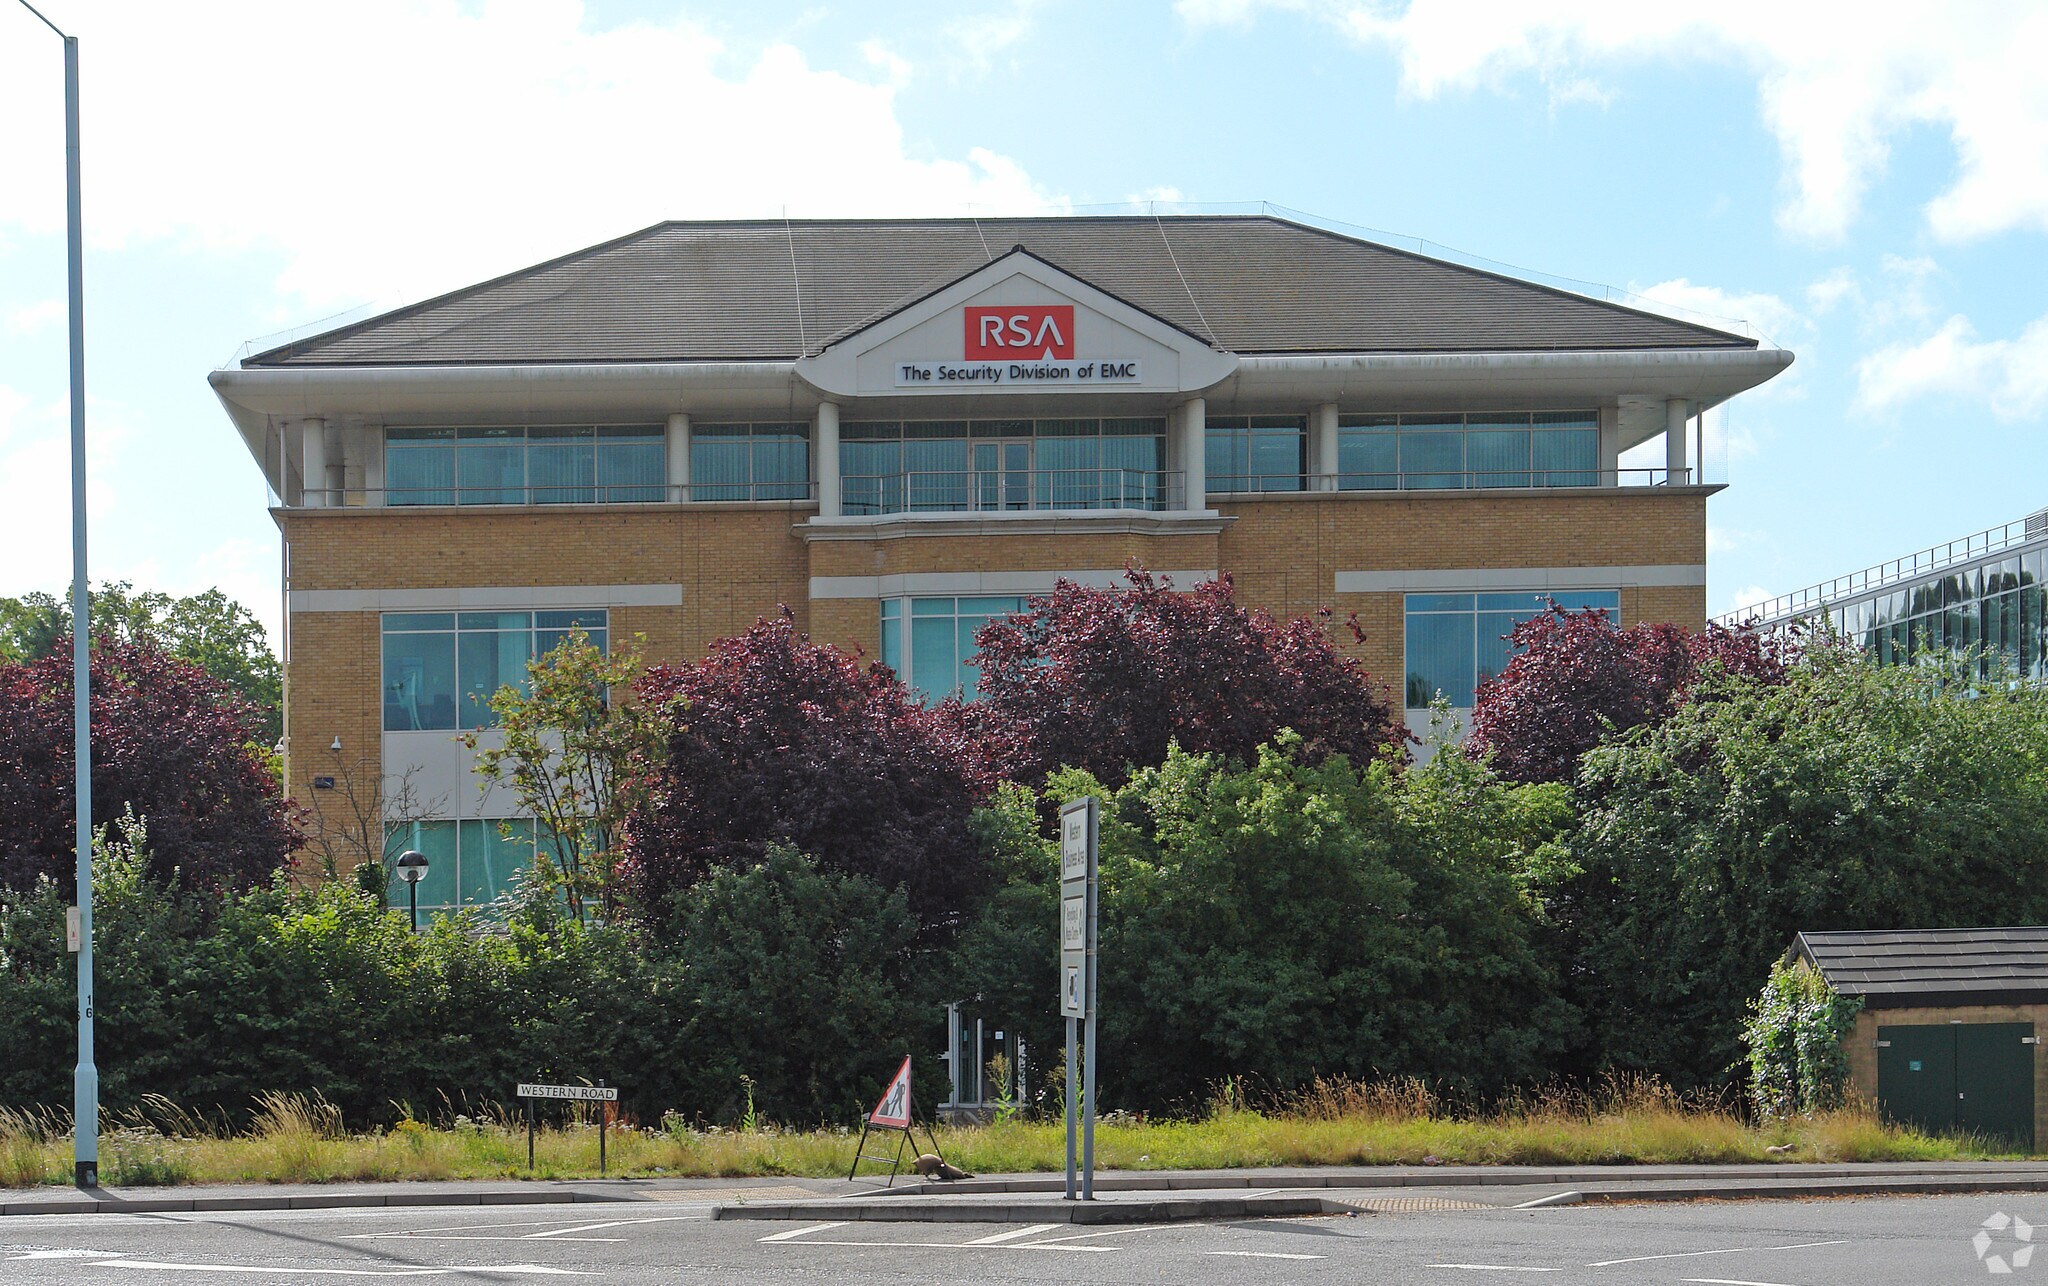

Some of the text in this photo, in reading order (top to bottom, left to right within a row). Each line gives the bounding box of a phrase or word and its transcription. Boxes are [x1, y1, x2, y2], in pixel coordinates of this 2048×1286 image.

[980, 315, 1065, 347] RSA
[902, 363, 1136, 383] The Security Division of EMC
[521, 1086, 614, 1099] WESTERN ROAD
